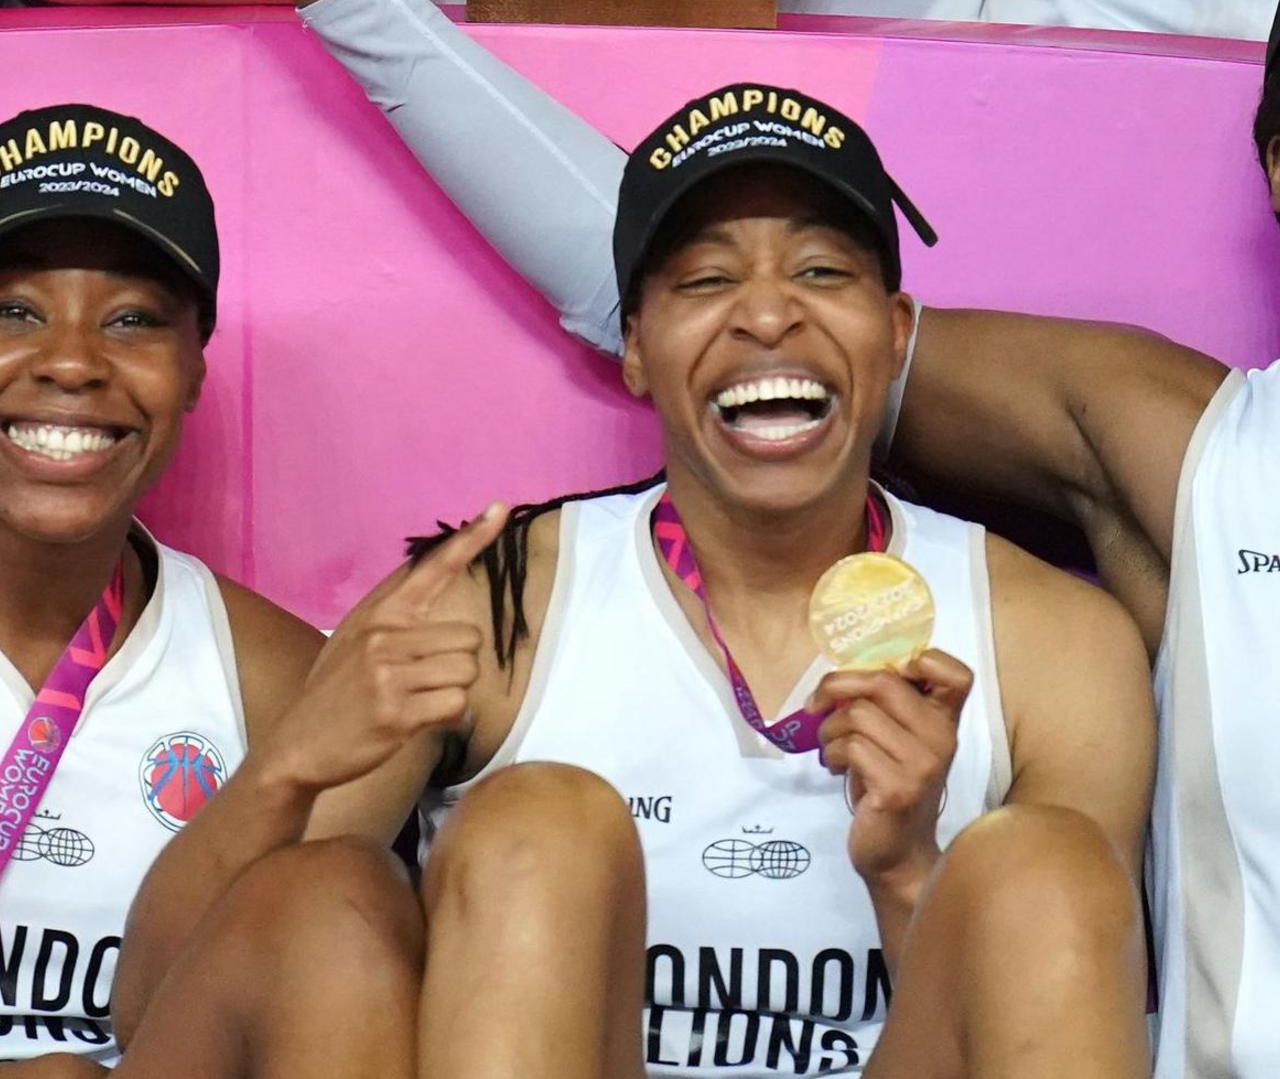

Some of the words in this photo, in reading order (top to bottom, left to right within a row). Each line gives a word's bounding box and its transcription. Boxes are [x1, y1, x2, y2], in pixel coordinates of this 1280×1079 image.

[649, 90, 845, 170] CHAMPIONS
[0, 163, 86, 188] EUROCUP
[90, 162, 157, 199] WOMEN
[646, 944, 892, 1021] ONDON
[647, 1005, 859, 1075] LIONS
